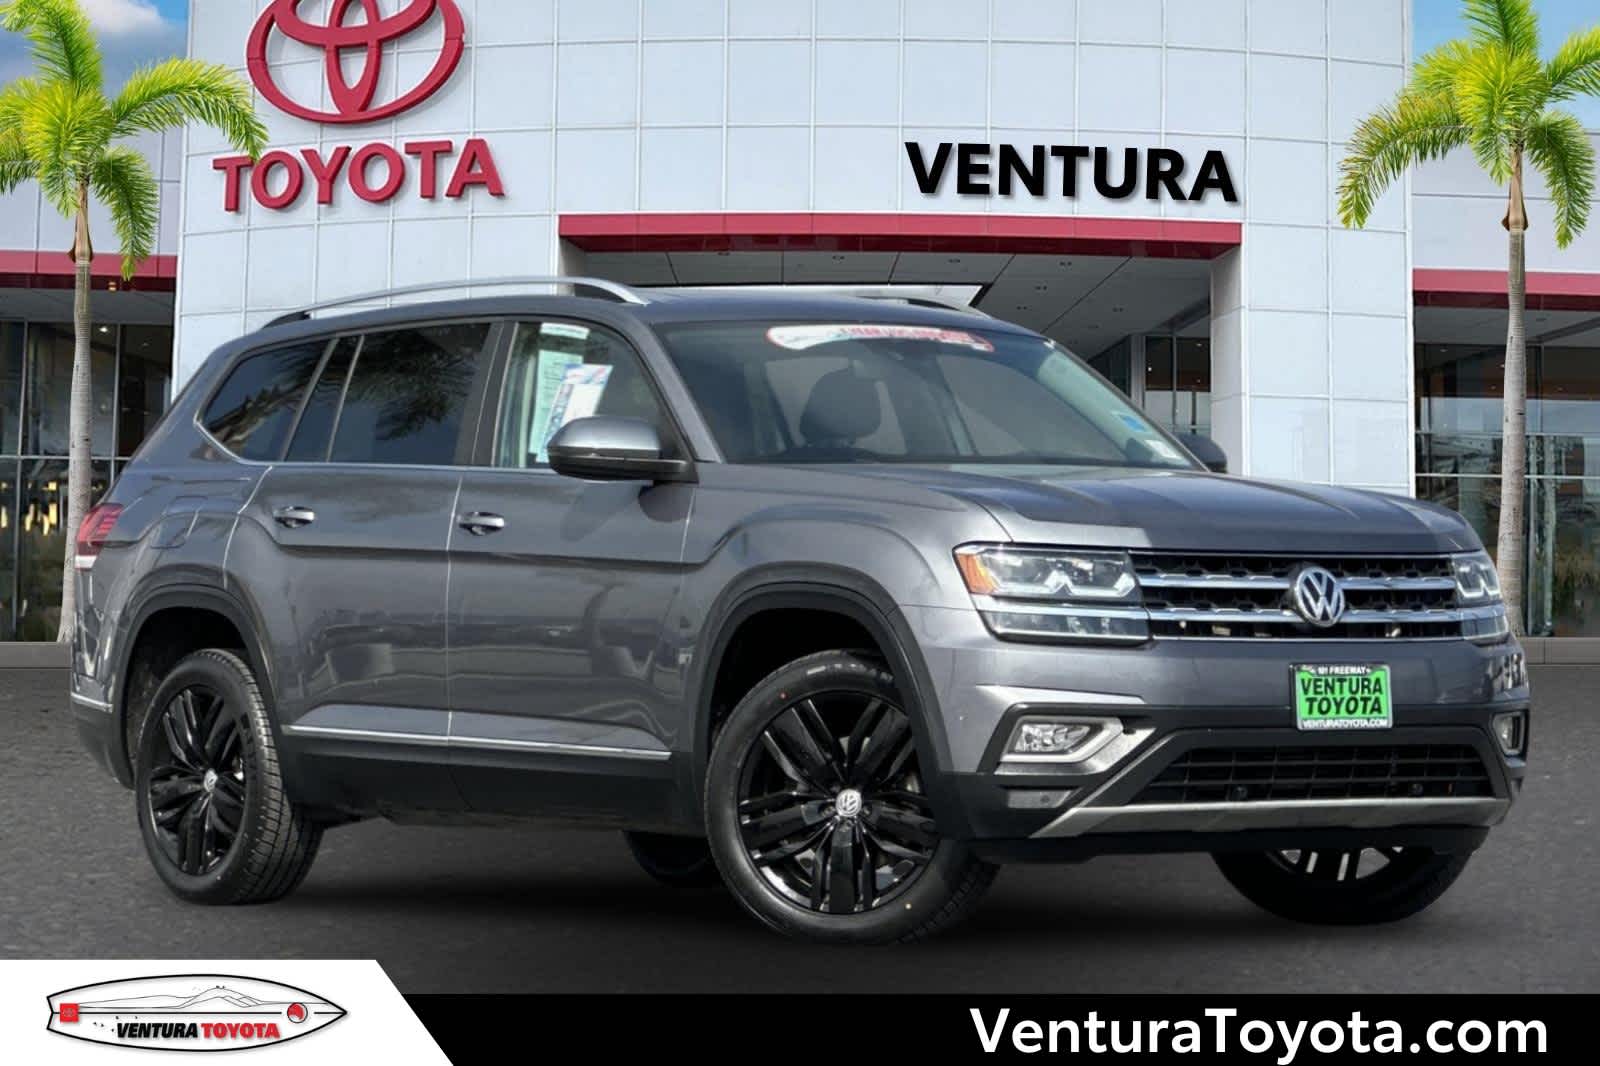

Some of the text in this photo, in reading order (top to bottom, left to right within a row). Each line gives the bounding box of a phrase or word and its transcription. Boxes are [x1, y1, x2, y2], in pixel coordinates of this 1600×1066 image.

[212, 138, 505, 212] TOYOTA
[904, 141, 1238, 202] VENTURA
[1301, 677, 1383, 695] VENTURA
[1305, 696, 1382, 715] TOYOTA
[1303, 718, 1388, 728] VENTURATOYOTA.COM
